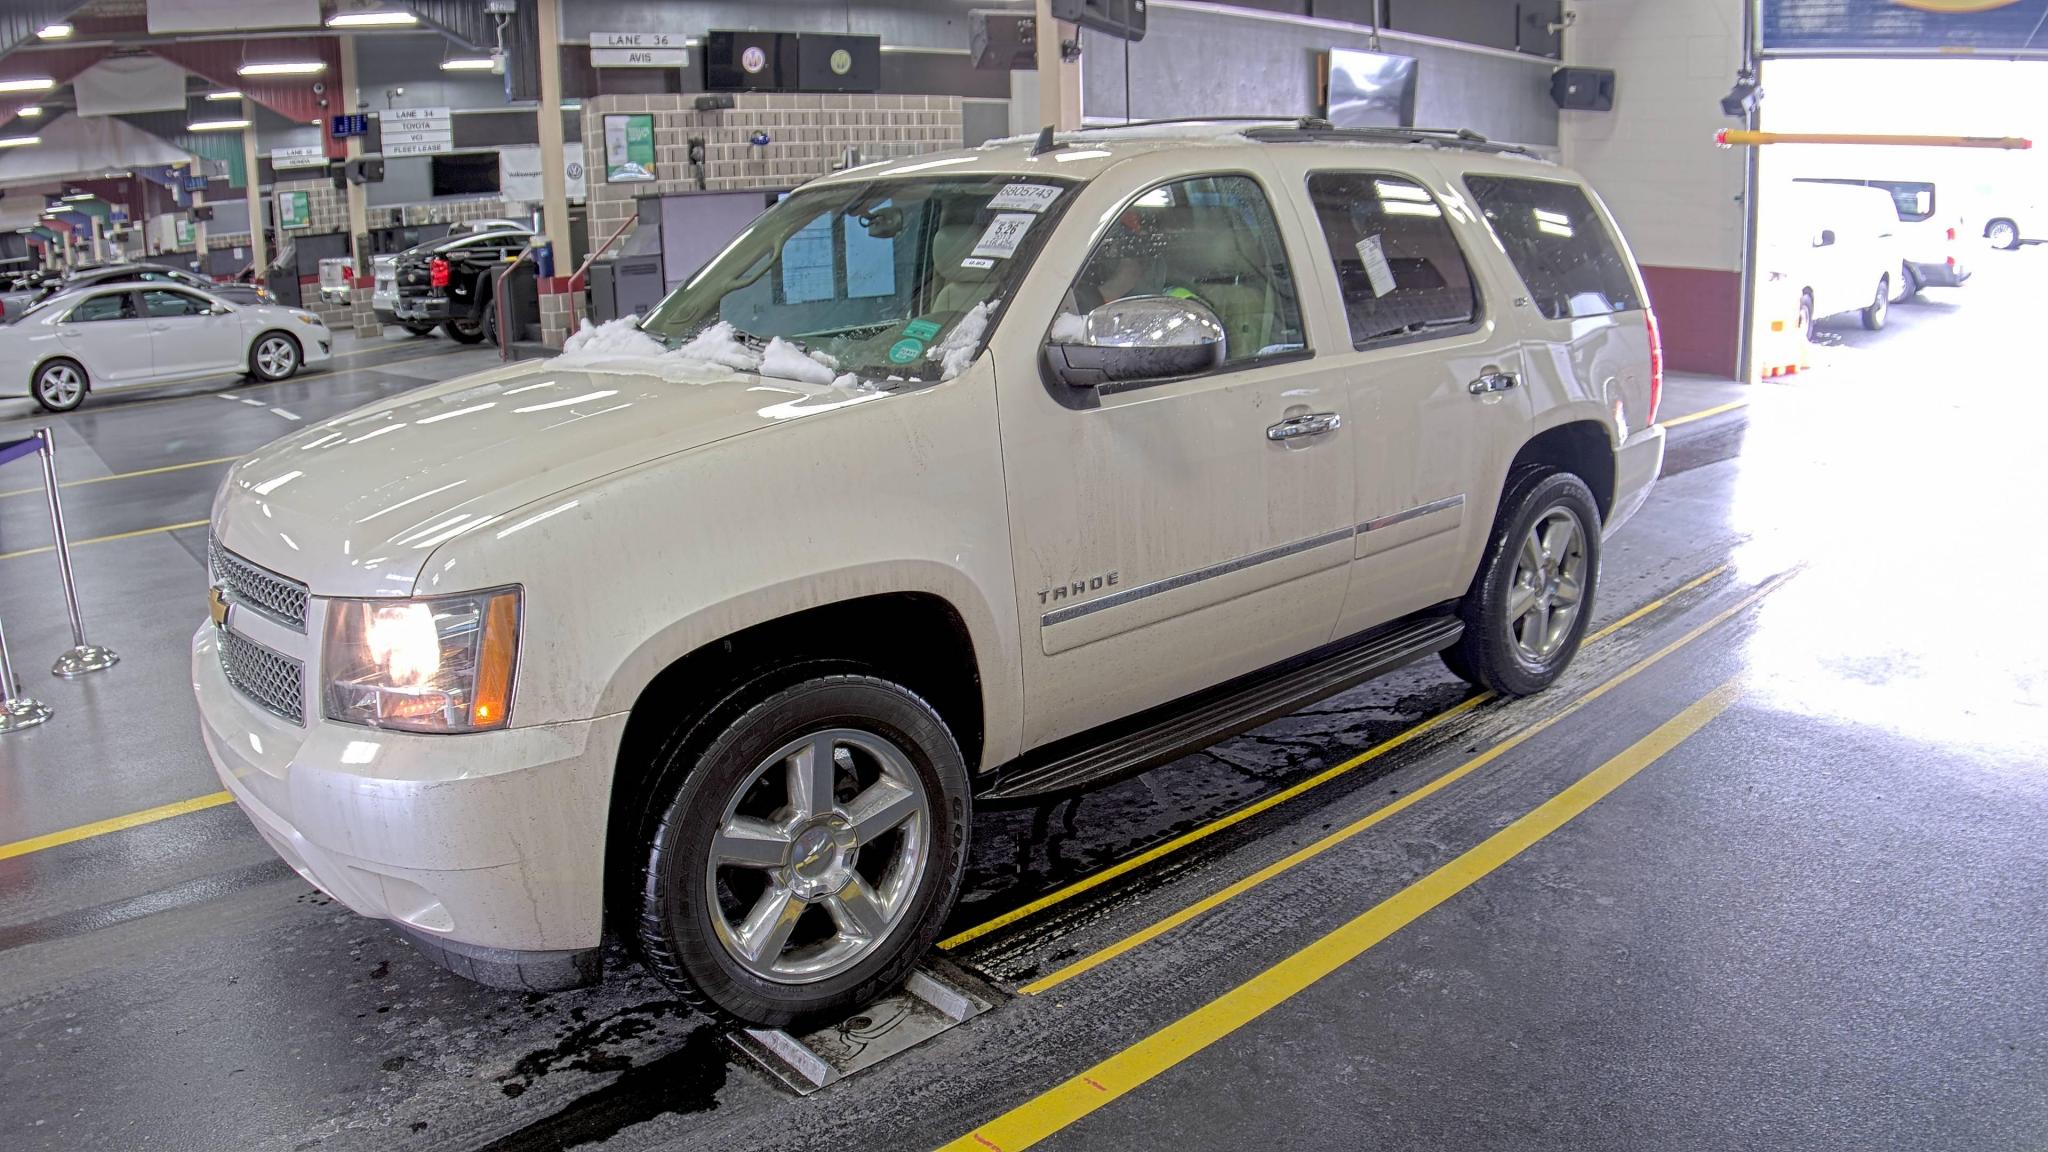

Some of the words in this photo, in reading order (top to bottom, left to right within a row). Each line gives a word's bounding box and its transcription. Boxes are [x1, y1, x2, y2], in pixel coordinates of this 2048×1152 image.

[608, 34, 641, 45] LANE
[654, 34, 669, 45] 36
[629, 52, 652, 63] AVIS
[396, 109, 417, 119] LANE
[402, 122, 431, 130] TOYOTA
[1037, 571, 1119, 604] TAHOE
